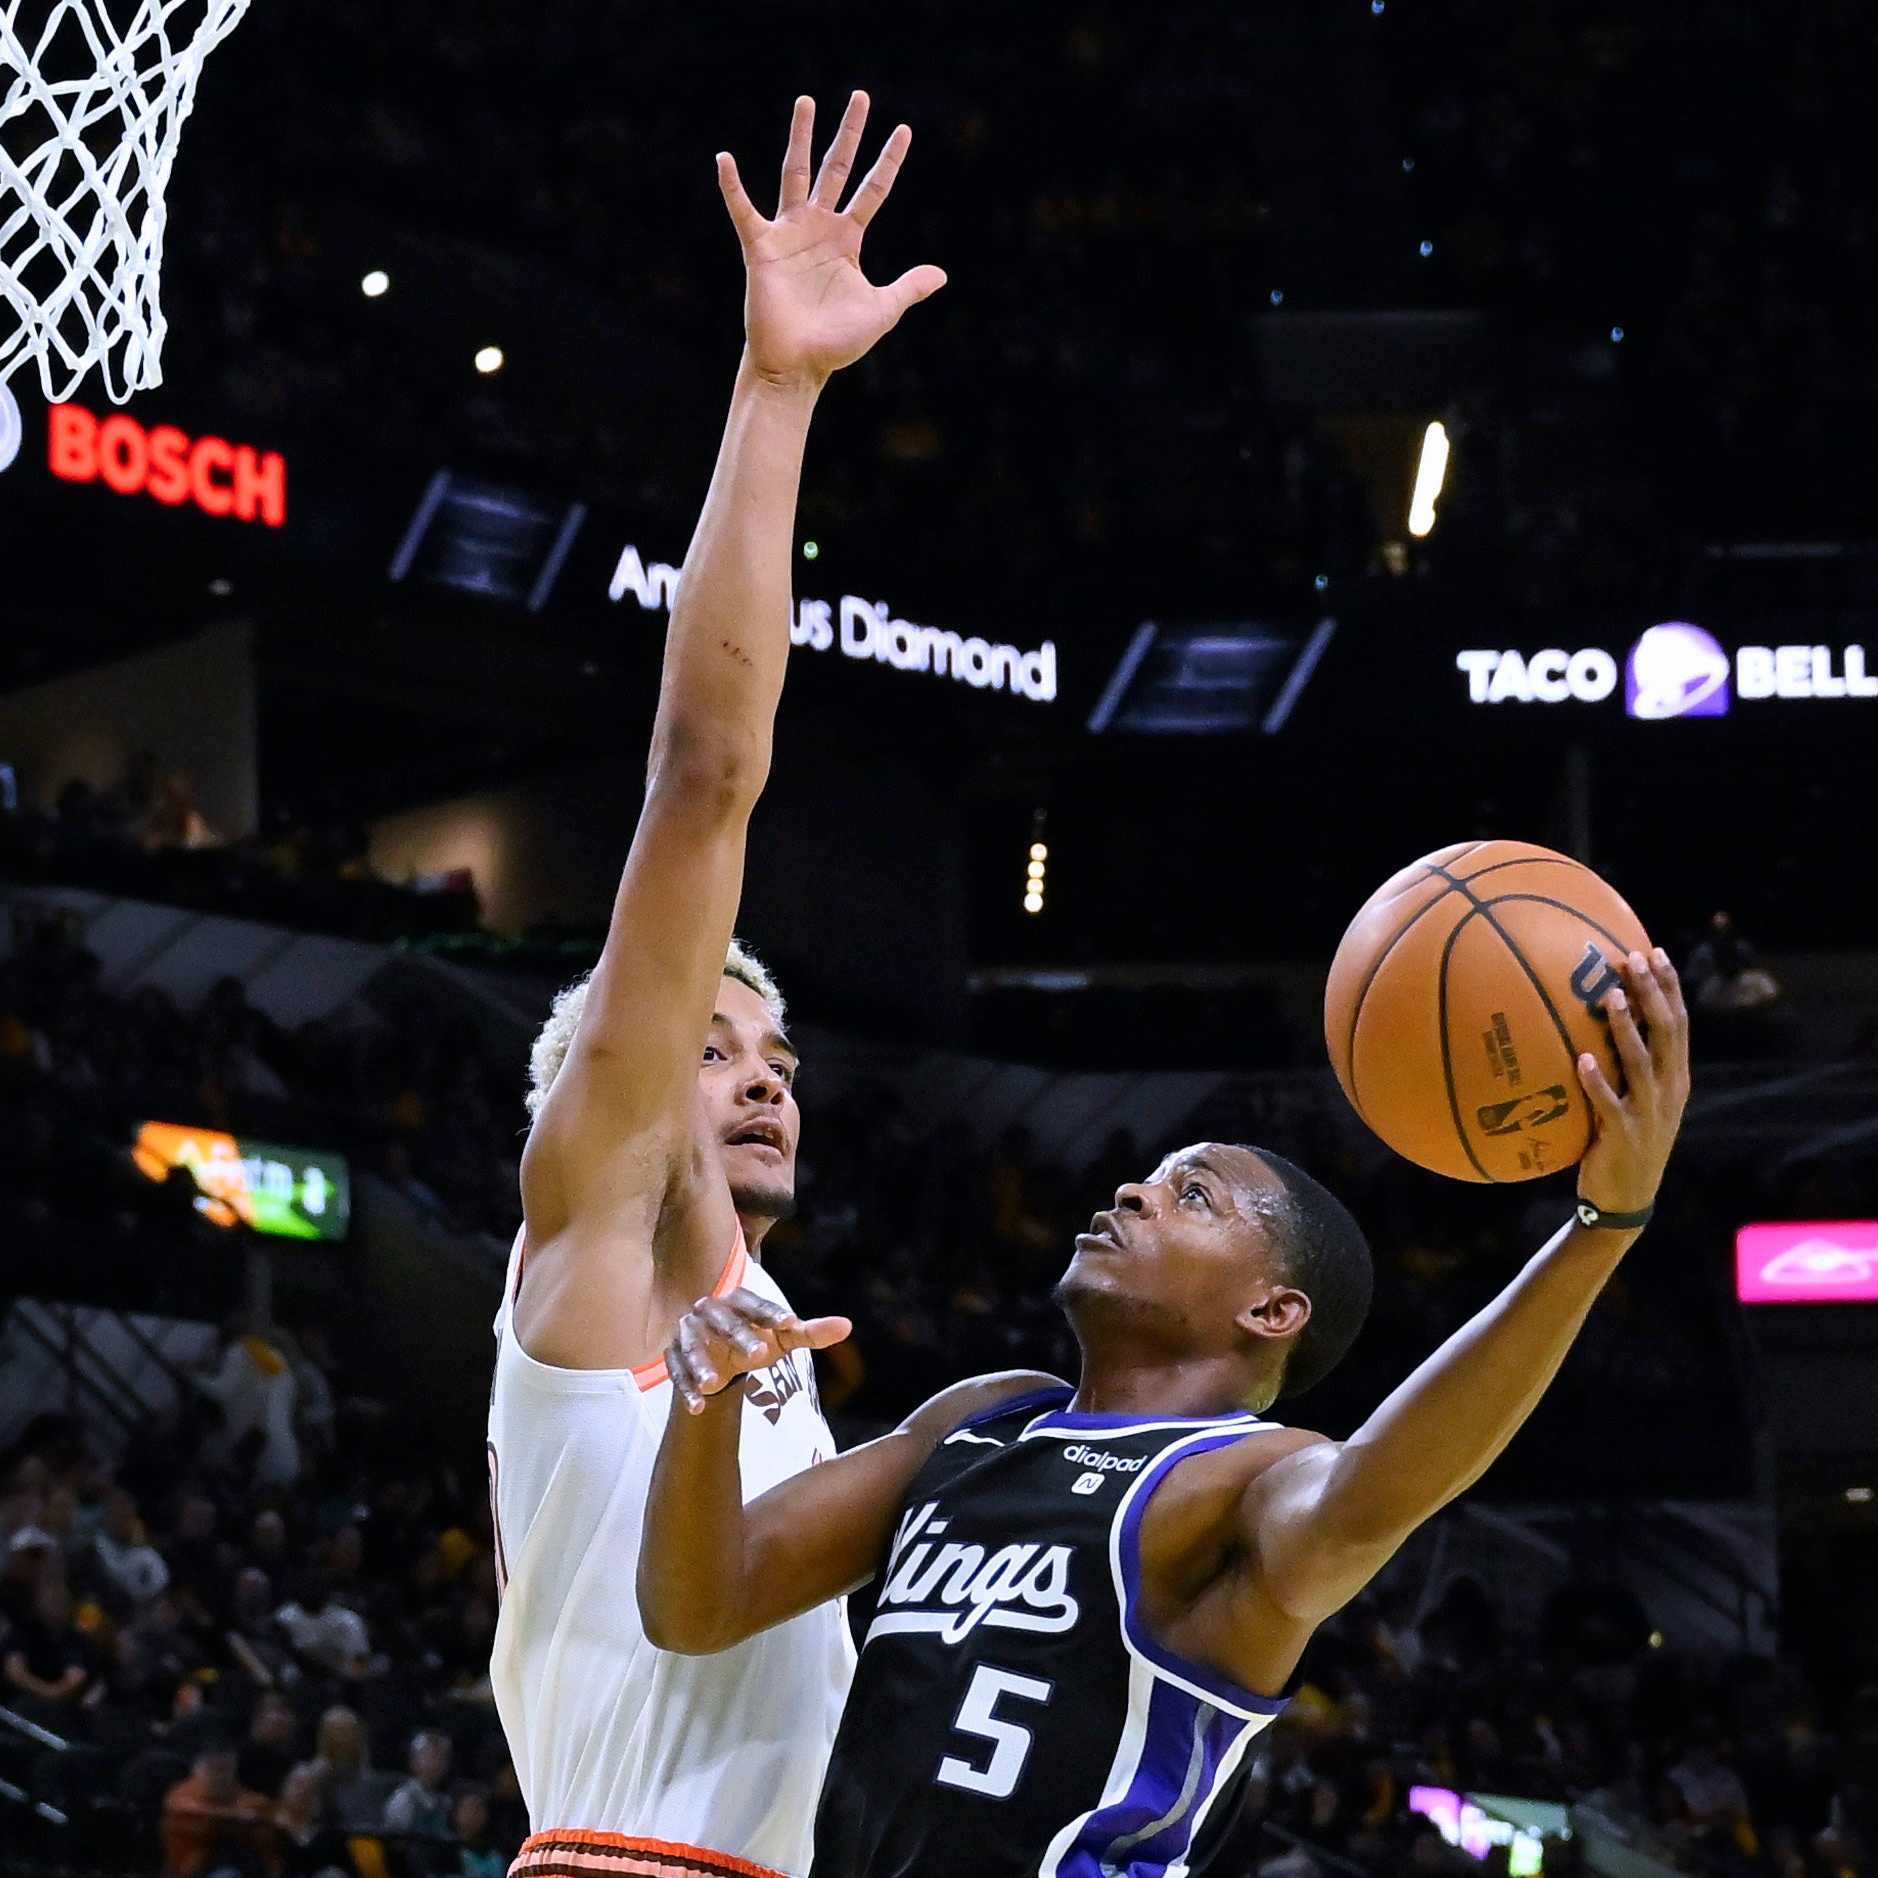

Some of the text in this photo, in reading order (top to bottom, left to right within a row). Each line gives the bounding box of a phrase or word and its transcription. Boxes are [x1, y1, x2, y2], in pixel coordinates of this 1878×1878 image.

[47, 401, 286, 530] BOSCH
[840, 594, 1057, 702] Diamond
[1456, 648, 1618, 703] TACO
[1063, 1444, 1148, 1472] dialpad
[935, 1663, 1055, 1799] 5
